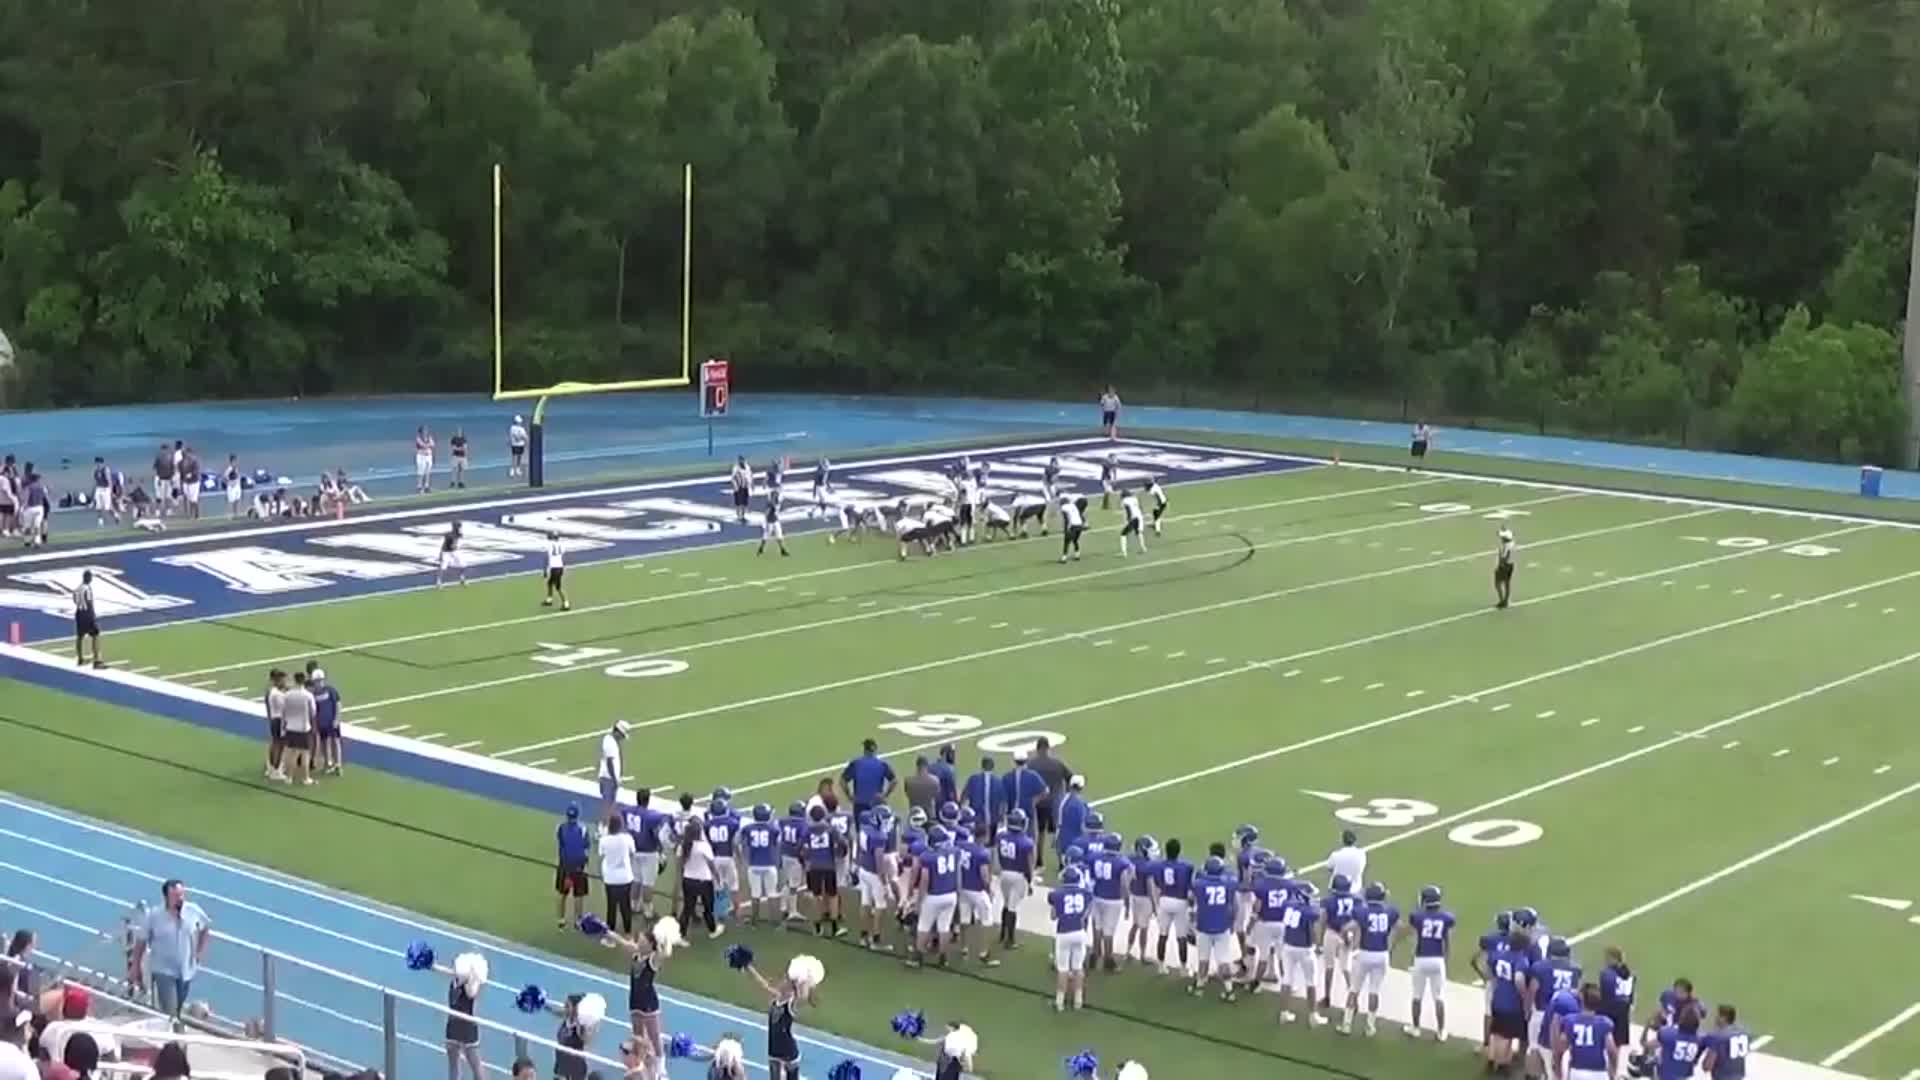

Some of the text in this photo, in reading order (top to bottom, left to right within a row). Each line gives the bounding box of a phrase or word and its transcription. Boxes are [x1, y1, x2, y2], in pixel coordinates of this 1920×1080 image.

[530, 648, 690, 677] 10
[877, 713, 1067, 752] 20
[1335, 798, 1543, 847] 30
[1064, 893, 1084, 914] 29
[1205, 885, 1226, 905] 72
[1337, 898, 1353, 916] 17
[1422, 918, 1444, 938] 27
[1573, 1024, 1594, 1046] 71
